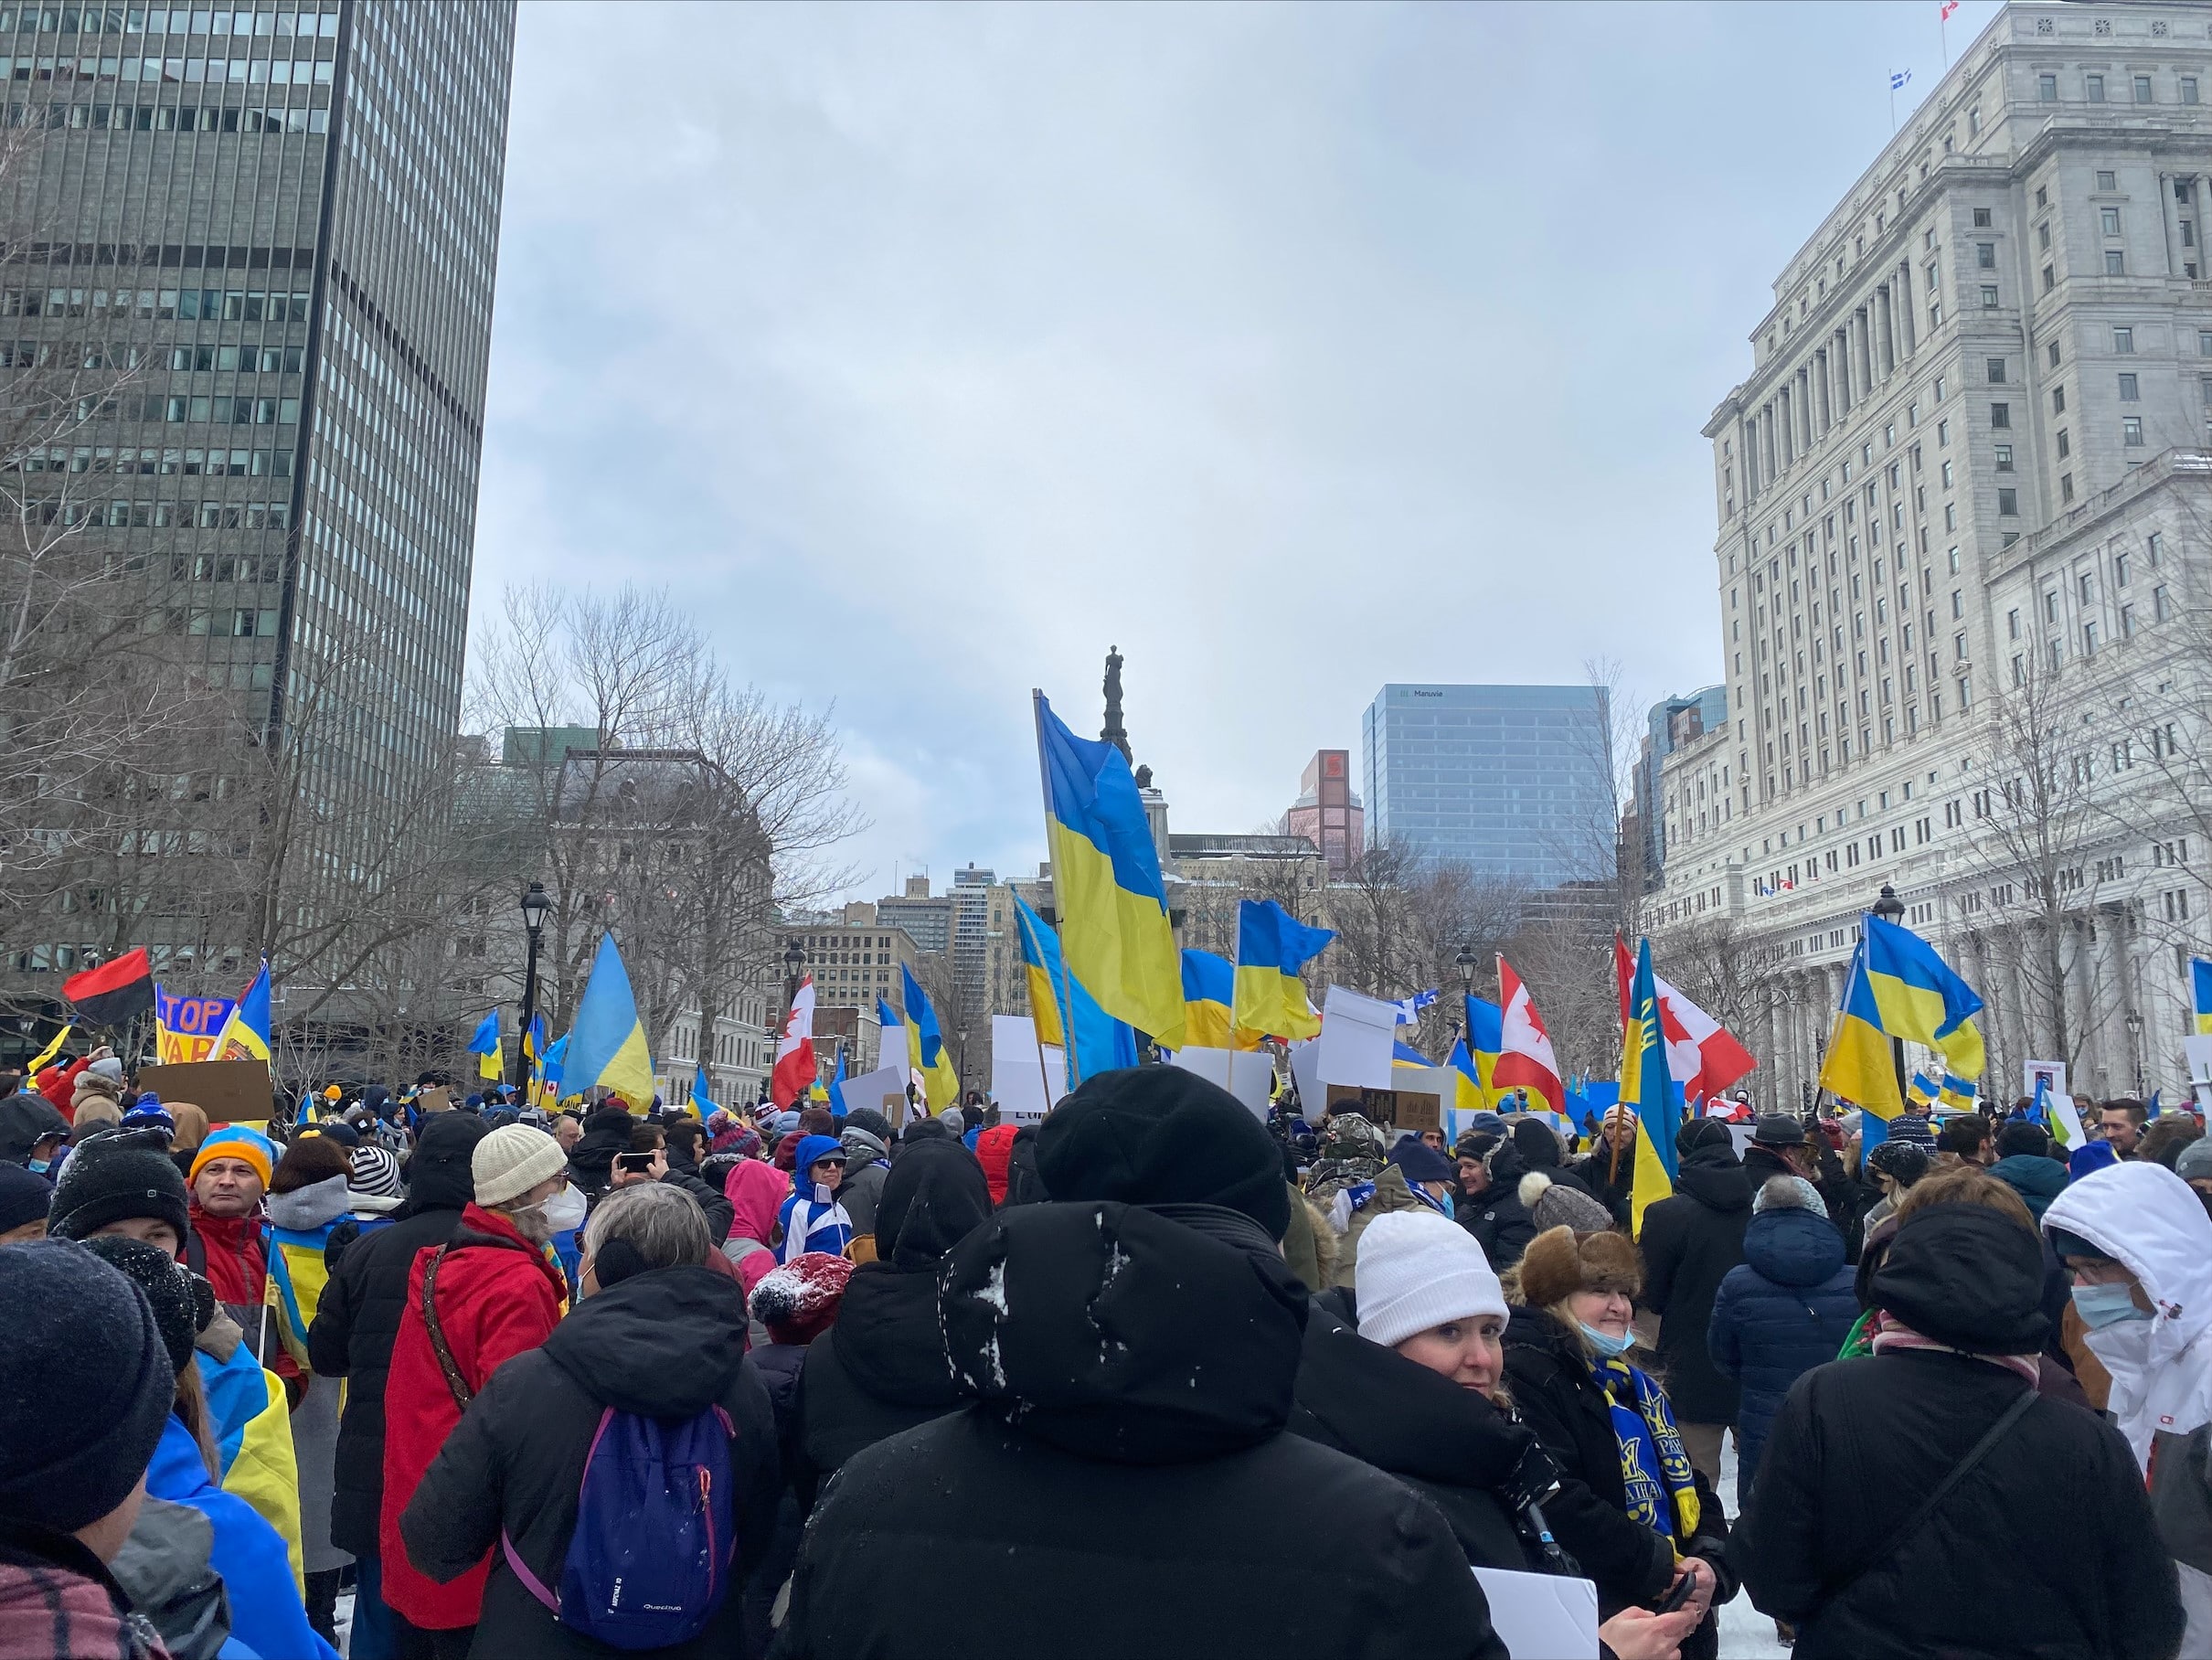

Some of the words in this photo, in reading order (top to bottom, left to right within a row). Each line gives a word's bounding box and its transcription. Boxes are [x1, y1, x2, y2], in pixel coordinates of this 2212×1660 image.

[1414, 689, 1443, 697] Manuvie
[162, 995, 224, 1033] TOP
[643, 1603, 682, 1612] Quechua
